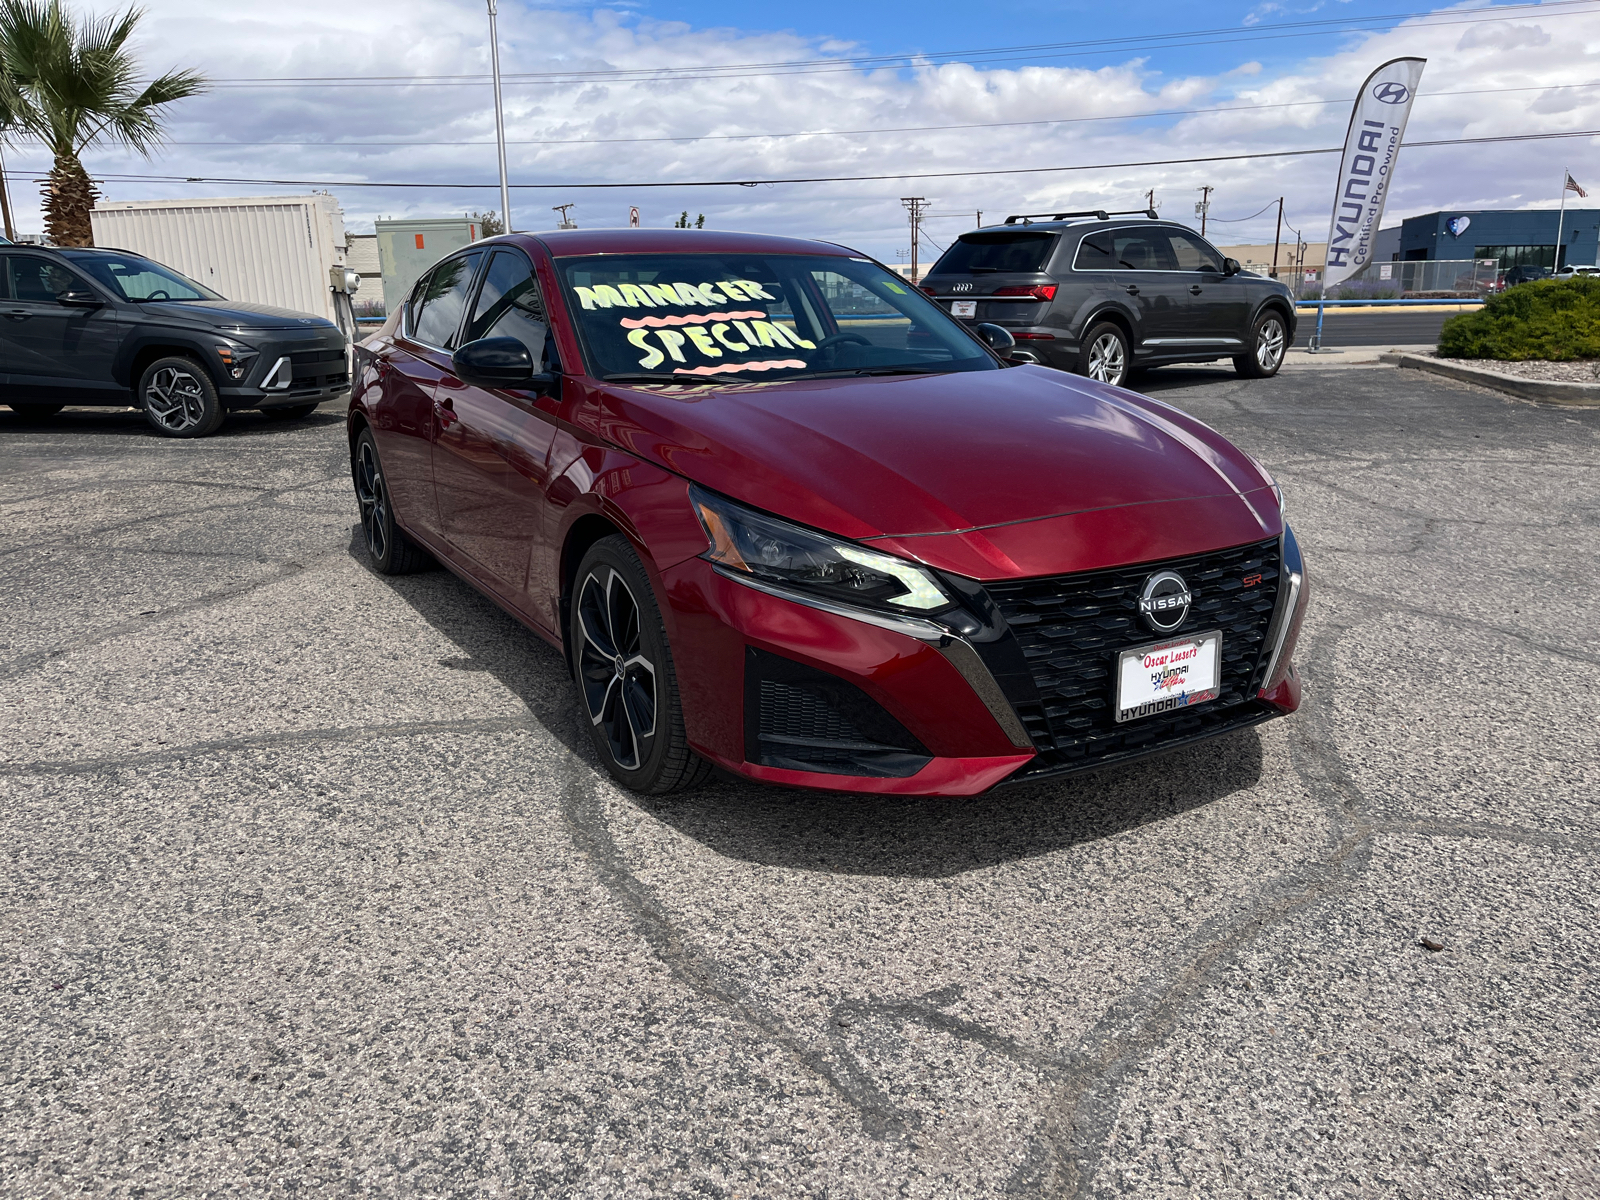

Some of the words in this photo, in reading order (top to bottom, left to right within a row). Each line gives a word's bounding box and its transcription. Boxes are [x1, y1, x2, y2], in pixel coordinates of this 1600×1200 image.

[1328, 120, 1385, 267] HYUNDAI
[1354, 207, 1378, 265] Certified
[1371, 127, 1400, 205] Pro-Owned
[573, 279, 776, 311] MANAGER
[626, 320, 817, 370] SPECIAL
[1243, 574, 1262, 588] SR
[1141, 593, 1192, 612] NISSAN
[1144, 654, 1169, 669] Oscar
[1169, 646, 1198, 663] Leeser's
[1153, 642, 1170, 651] Oscar
[1151, 665, 1189, 682] HYUNDAI
[1121, 697, 1177, 721] HYUNDAI
